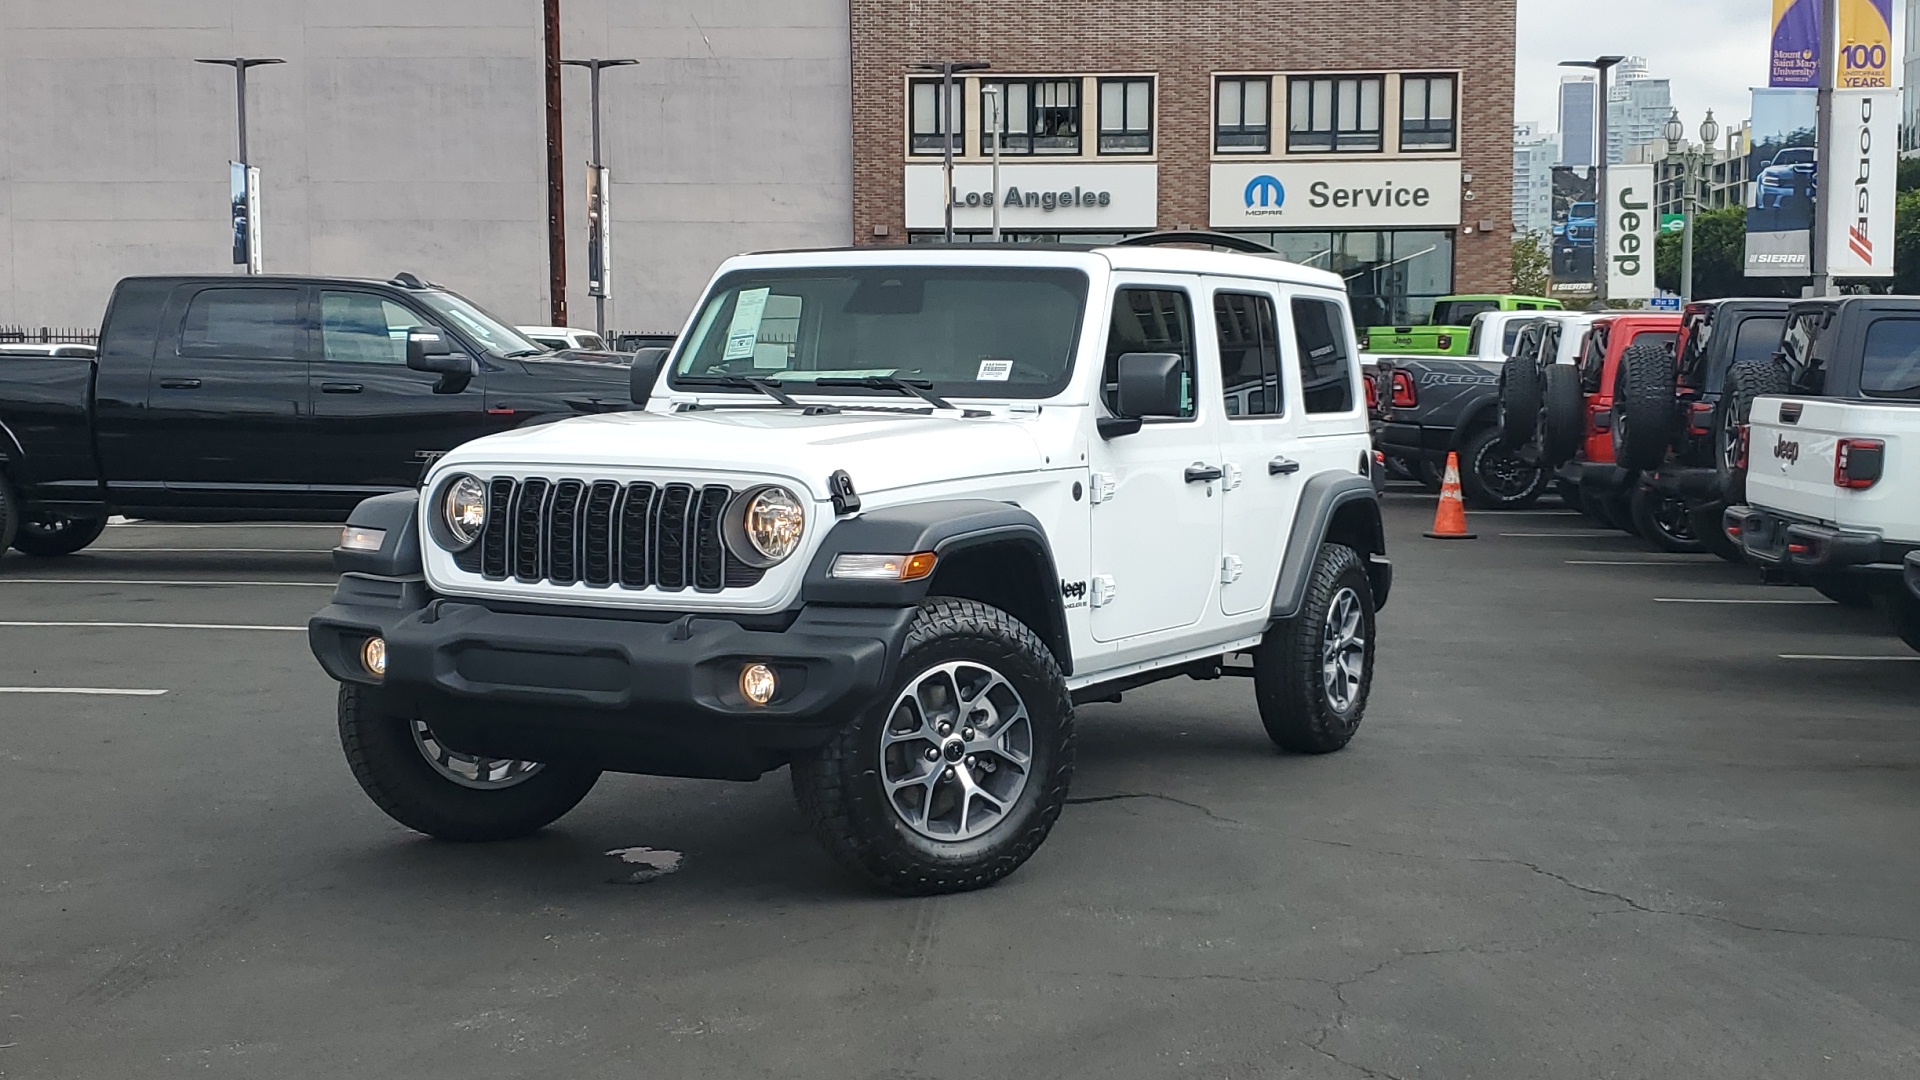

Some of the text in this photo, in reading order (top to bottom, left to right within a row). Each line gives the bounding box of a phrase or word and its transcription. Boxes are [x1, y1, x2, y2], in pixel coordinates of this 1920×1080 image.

[1773, 59, 1794, 67] Saint
[1774, 50, 1800, 59] Mount
[1841, 44, 1886, 69] 100
[1773, 67, 1815, 78] University
[1844, 77, 1886, 87] YEARS
[1856, 98, 1872, 241] DODGE
[952, 186, 1111, 212] Los Angeles
[1309, 180, 1430, 208] Service
[1613, 187, 1648, 276] Jeep
[1757, 254, 1806, 263] SIERRA
[1774, 433, 1799, 465] Jeep
